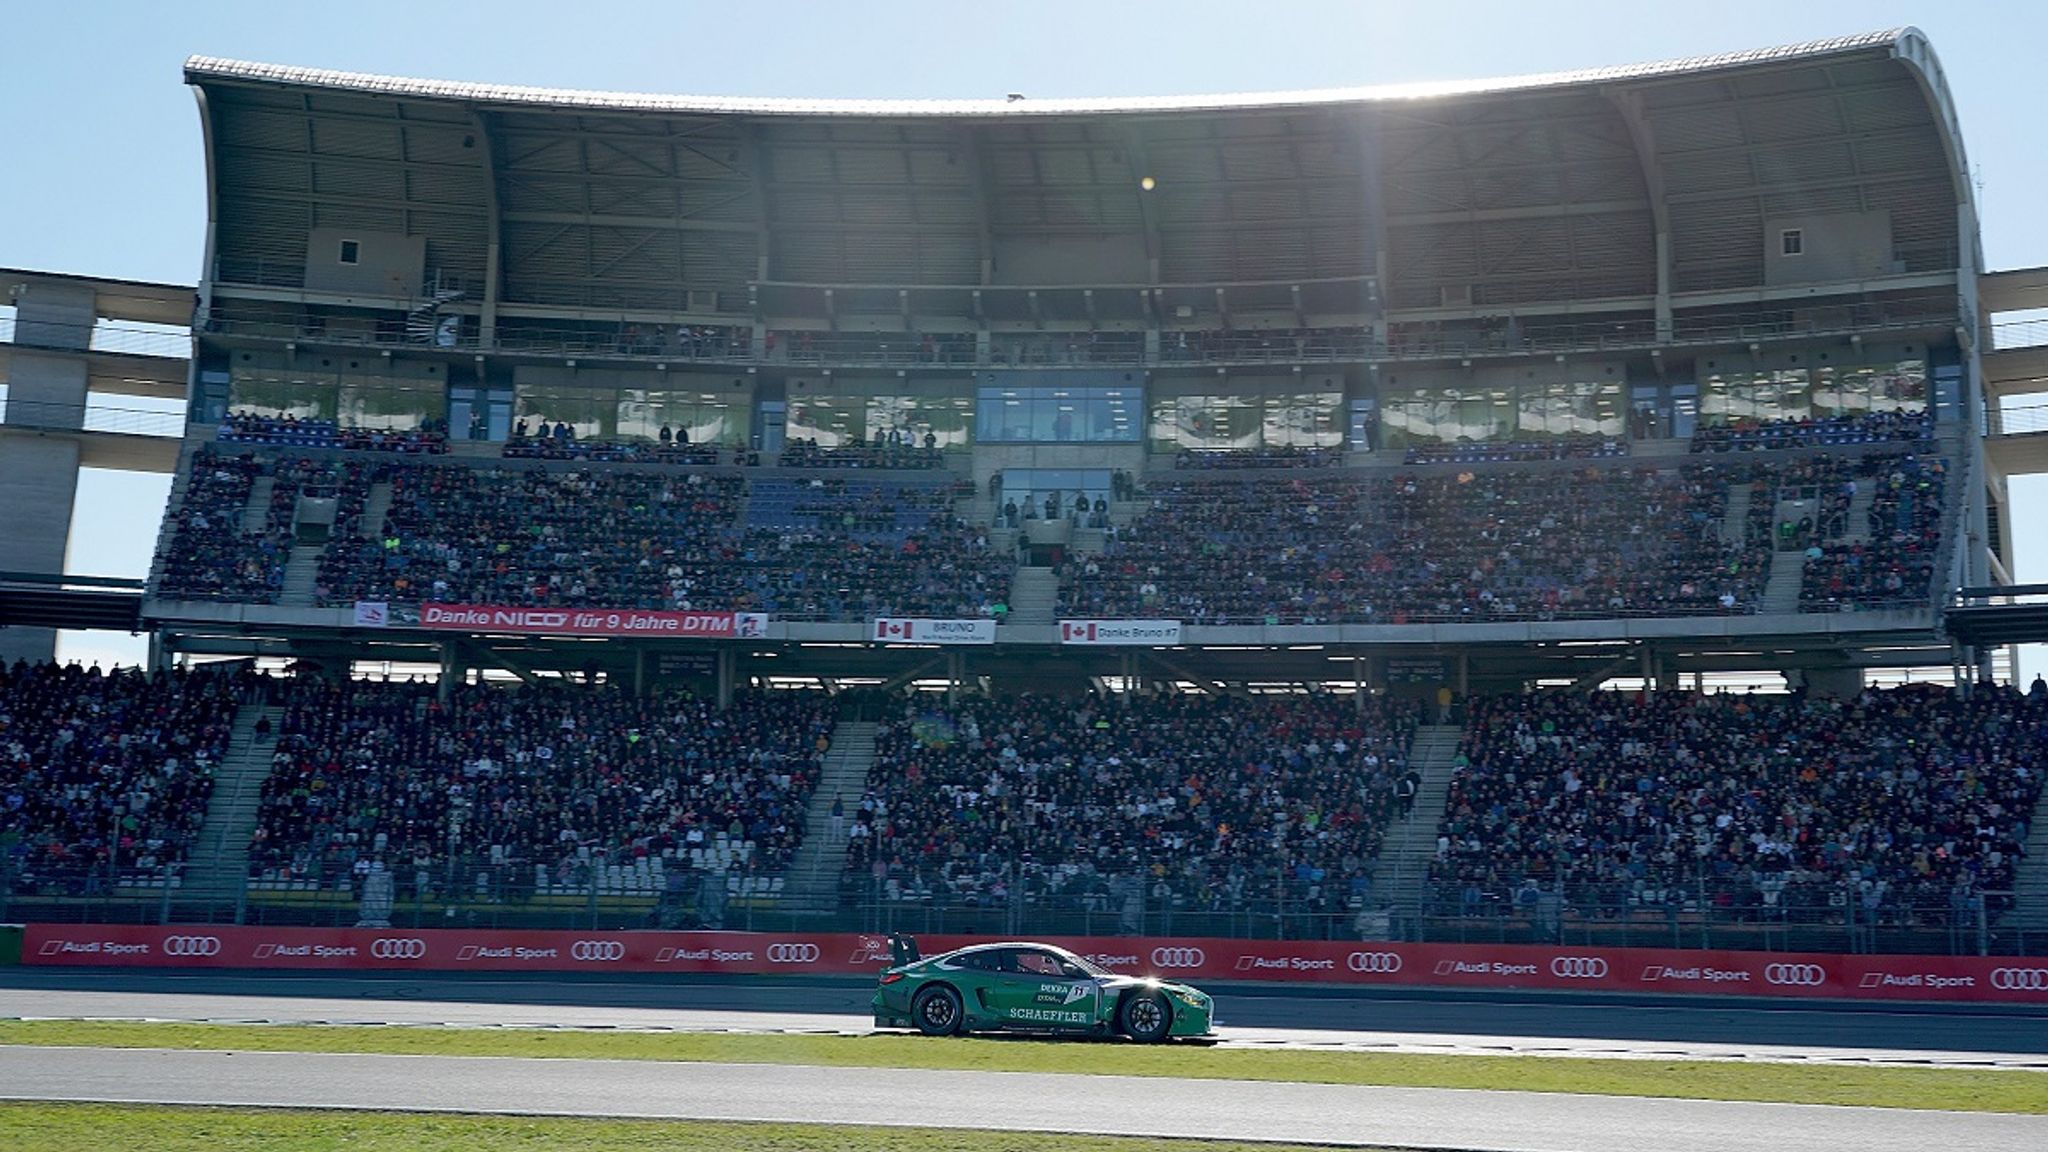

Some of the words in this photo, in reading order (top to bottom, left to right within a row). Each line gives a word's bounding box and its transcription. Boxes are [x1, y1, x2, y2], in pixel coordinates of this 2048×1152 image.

[425, 607, 490, 624] Danke
[494, 611, 568, 626] NICO
[573, 613, 603, 628] für
[606, 614, 620, 628] 9
[623, 615, 678, 630] Jahre
[683, 616, 730, 631] DTM
[933, 622, 976, 633] BRUNO
[1099, 628, 1130, 638] Danke
[1132, 628, 1162, 638] Bruno
[1165, 628, 1178, 638] #7
[62, 941, 100, 953] Audi
[103, 942, 149, 955] Sport
[274, 944, 310, 956] Audi
[313, 945, 358, 959] Sport
[476, 946, 512, 957] Audi
[514, 946, 557, 960] Sport
[674, 948, 710, 960] Audi
[712, 949, 754, 962] Sport
[1097, 954, 1139, 967] Sport
[1254, 957, 1289, 969] Audi
[1291, 958, 1334, 972] Sport
[1454, 961, 1490, 973] Audi
[1493, 962, 1537, 976] Sport
[1662, 967, 1700, 980] Audi
[1702, 968, 1750, 983] Sport
[1882, 973, 1921, 986] Audi
[1925, 974, 1975, 989] Sport
[1010, 1008, 1087, 1023] SCHAEFFLER
